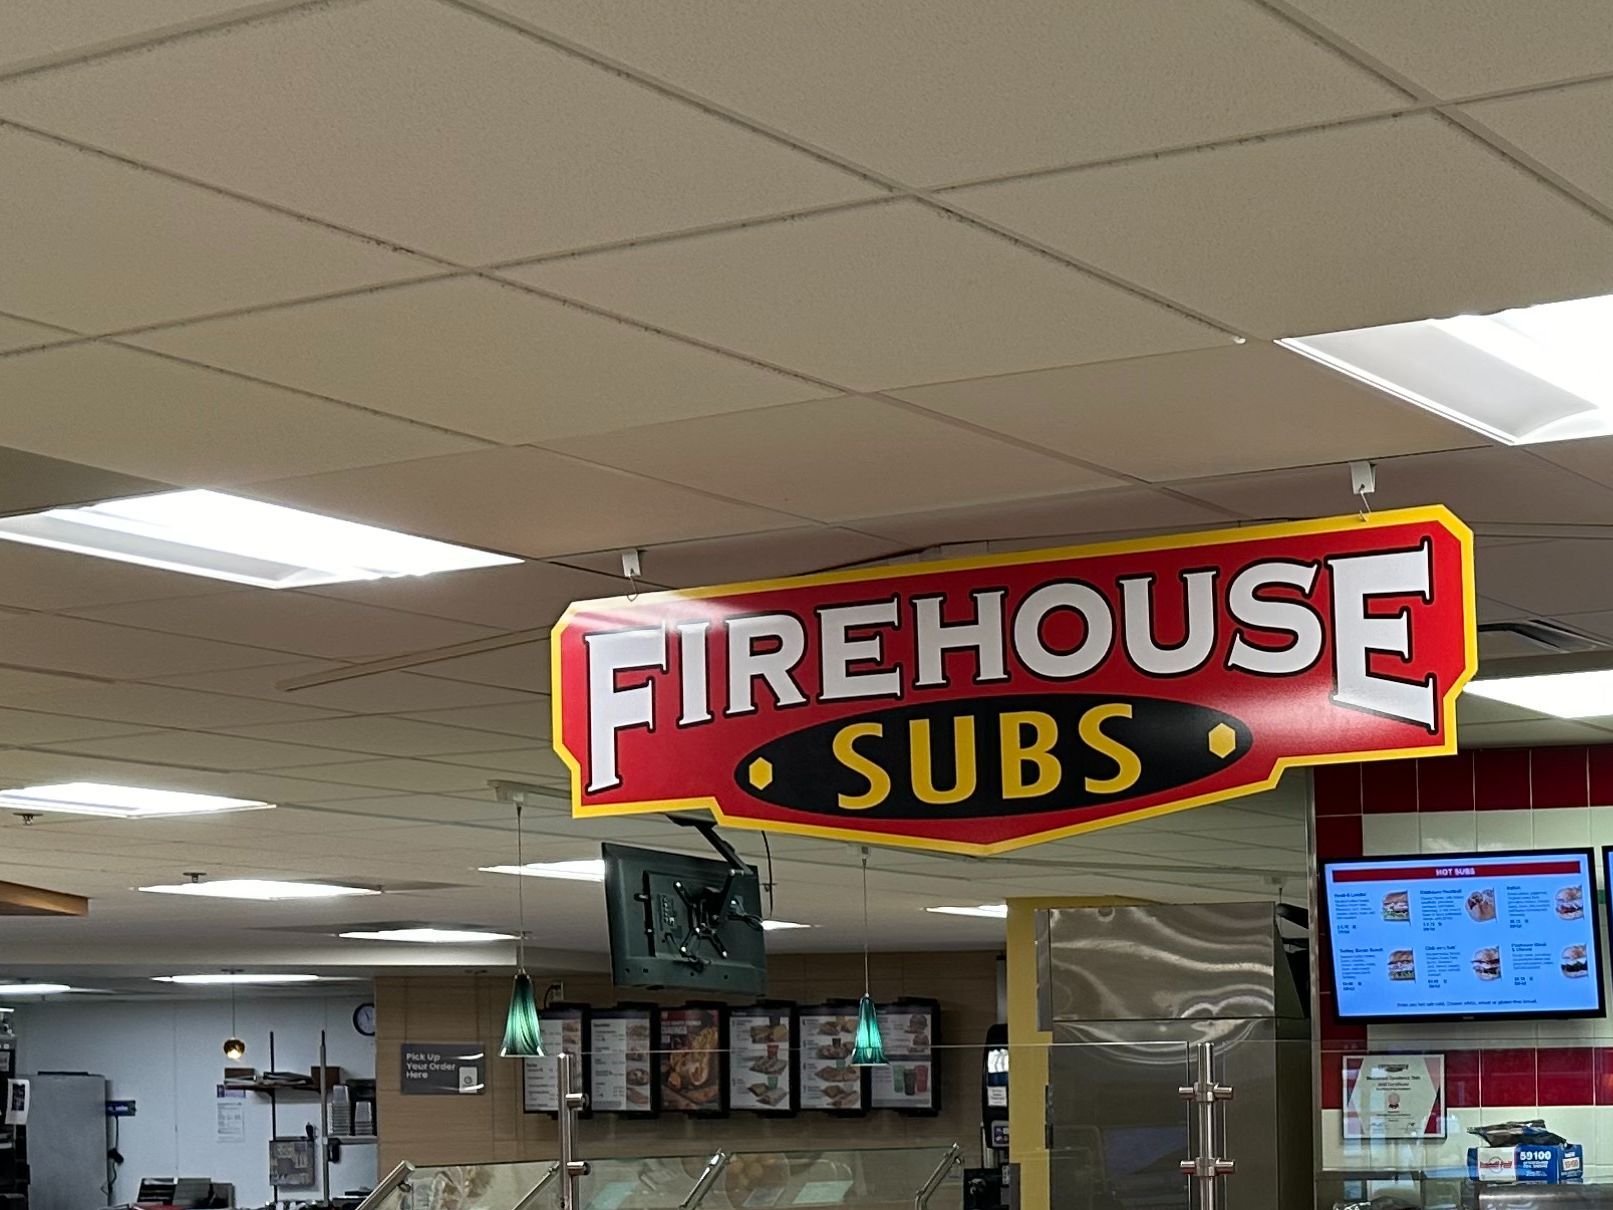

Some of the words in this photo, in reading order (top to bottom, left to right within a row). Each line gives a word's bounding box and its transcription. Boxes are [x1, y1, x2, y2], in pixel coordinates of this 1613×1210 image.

[582, 539, 1439, 794] FIREHOUSE
[830, 702, 1145, 810] SUBS
[1435, 868, 1453, 876] HOT
[1454, 867, 1476, 876] SUBS
[406, 1053, 426, 1061] Pick
[427, 1053, 441, 1062] Up
[406, 1062, 428, 1070] Your
[429, 1062, 456, 1071] Order
[406, 1071, 428, 1079] Here
